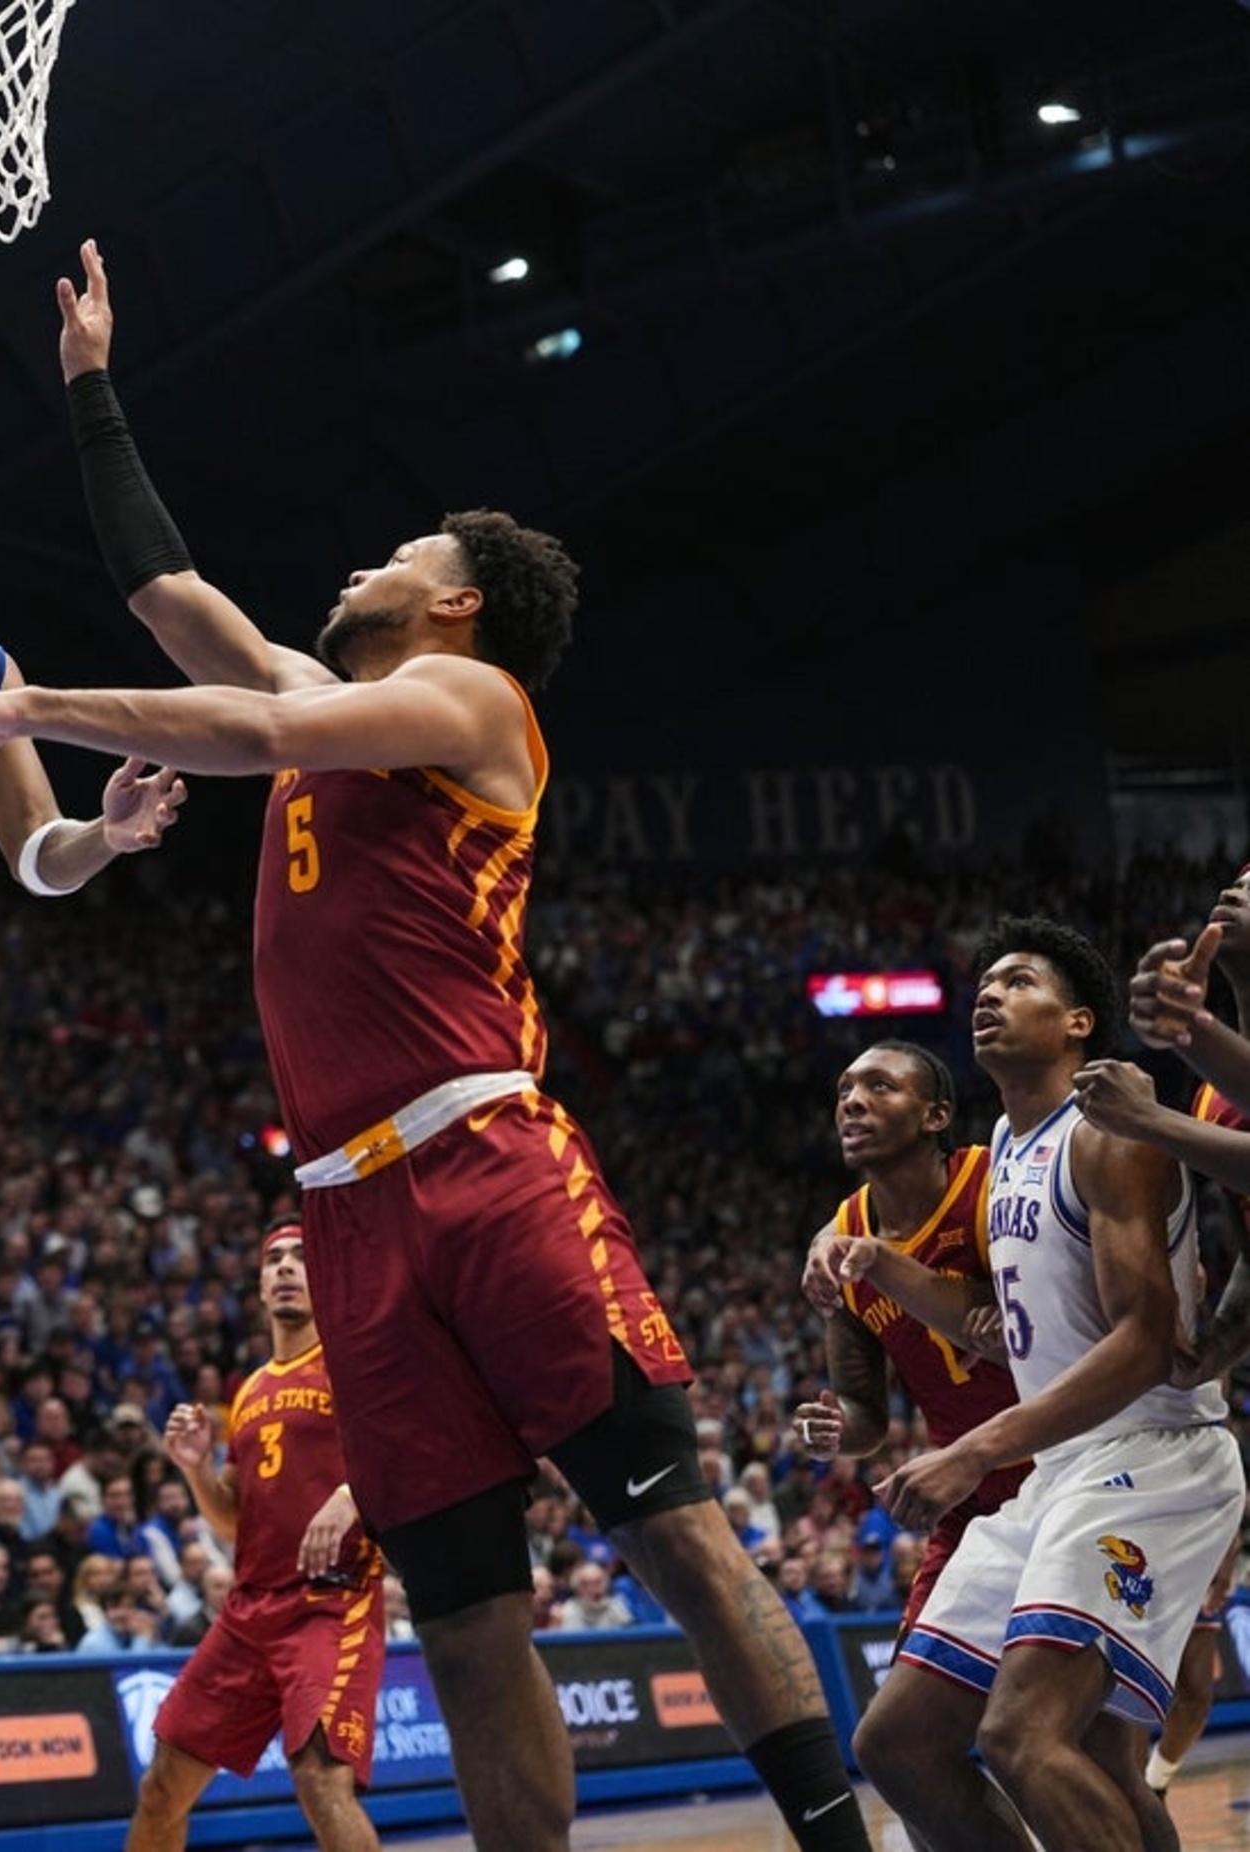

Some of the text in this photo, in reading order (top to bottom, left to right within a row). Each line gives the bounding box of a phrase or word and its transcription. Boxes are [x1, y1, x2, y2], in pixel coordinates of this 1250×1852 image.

[551, 763, 977, 861] PAY HEED
[287, 795, 320, 893] 5
[274, 1388, 333, 1415] STATE
[258, 1422, 284, 1479] 3
[42, 1735, 82, 1755] NOW
